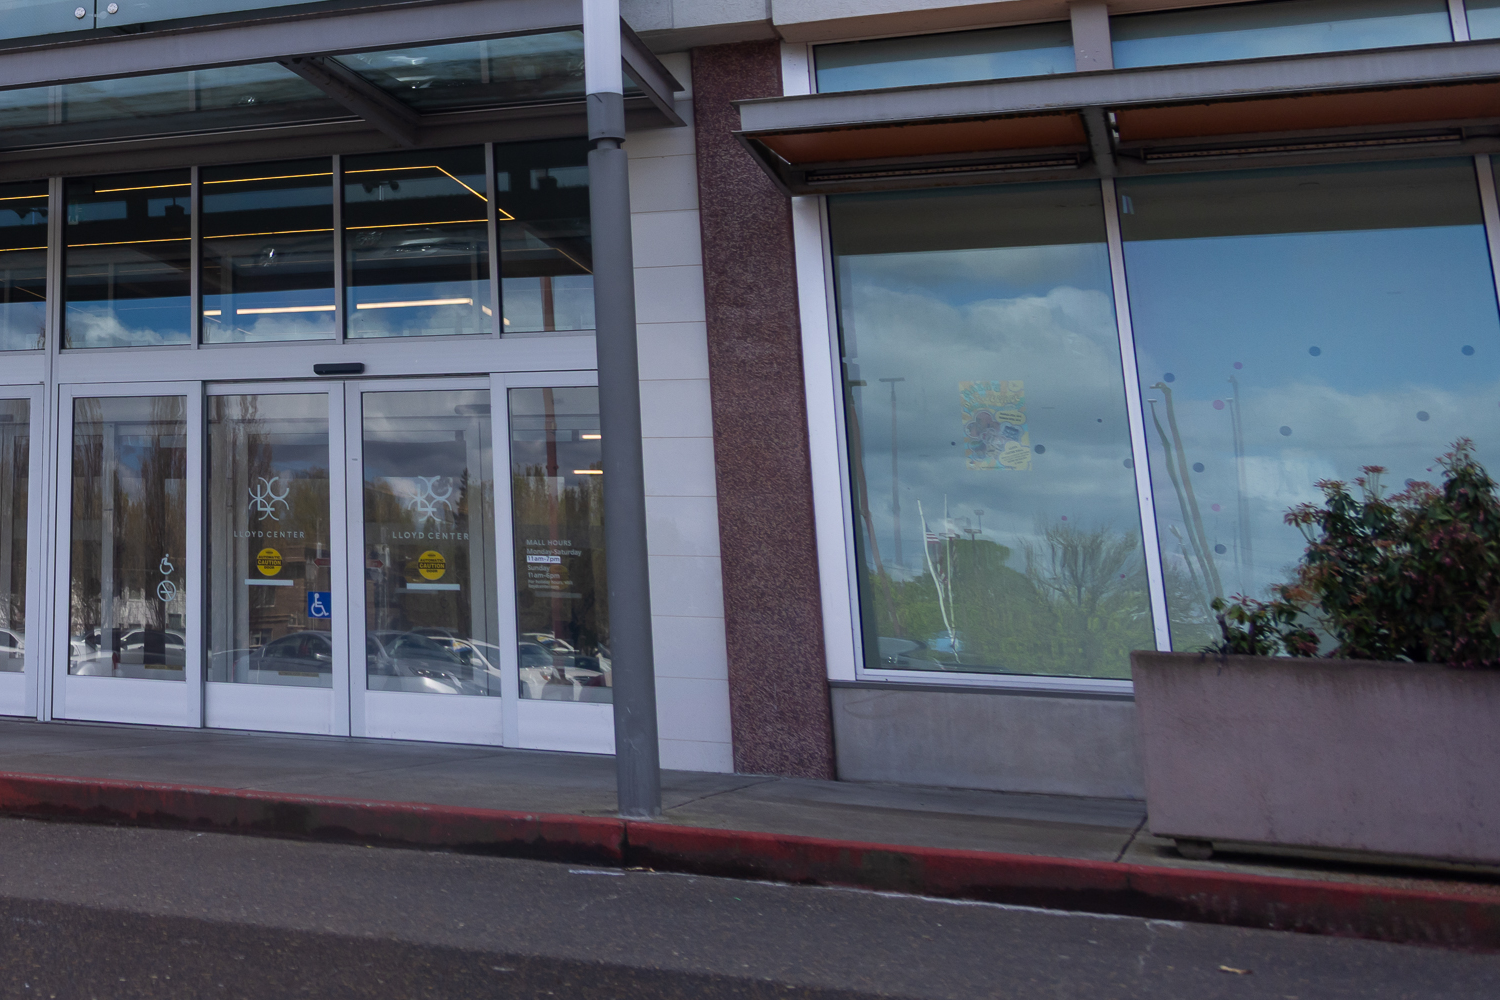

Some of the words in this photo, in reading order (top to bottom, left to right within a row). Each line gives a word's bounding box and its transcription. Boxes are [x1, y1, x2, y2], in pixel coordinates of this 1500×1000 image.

[233, 530, 264, 538] LLOYD
[392, 531, 425, 539] LLOYD
[428, 532, 469, 540] CENTER
[526, 548, 582, 557] Monday-Saturday
[527, 564, 550, 572] Sunday
